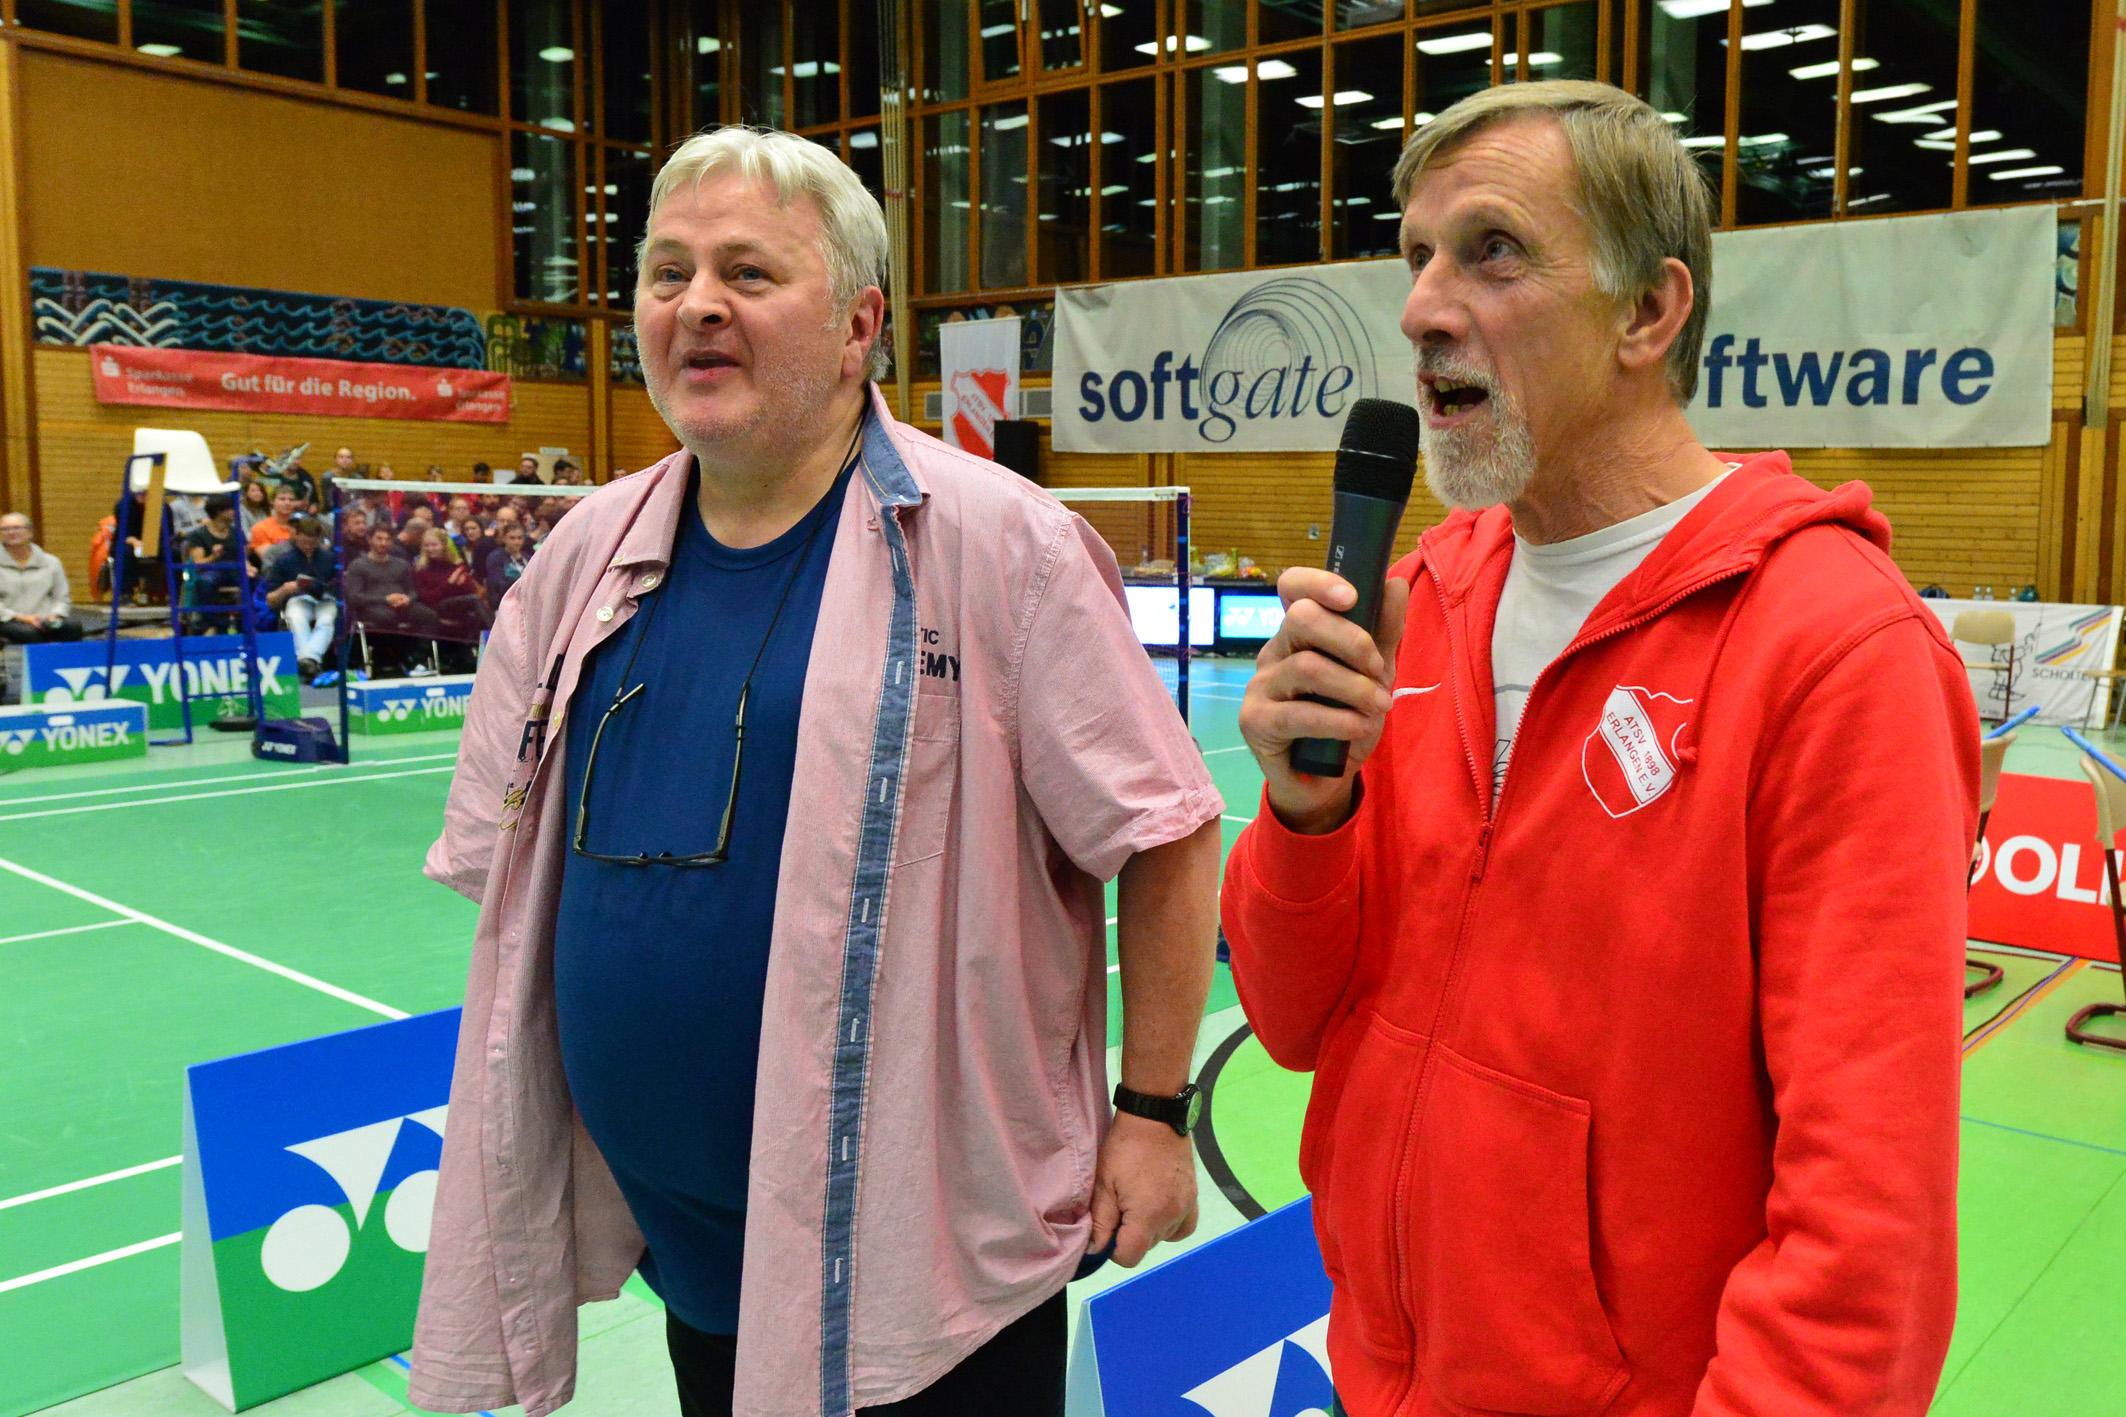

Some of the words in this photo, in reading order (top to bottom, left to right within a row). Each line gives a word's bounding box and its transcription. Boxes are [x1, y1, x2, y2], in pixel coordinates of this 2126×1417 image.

[220, 371, 260, 392] Gut
[264, 374, 295, 393] für
[300, 377, 333, 397] die
[338, 379, 416, 404] Region.
[1079, 351, 1354, 443] softgate
[1703, 334, 1995, 409] ftware
[139, 656, 283, 705] YONEX
[41, 720, 130, 752] YONEX
[1606, 711, 1643, 773] ERLANGEN
[1623, 715, 1647, 745] ATSV
[1643, 750, 1661, 777] 1898
